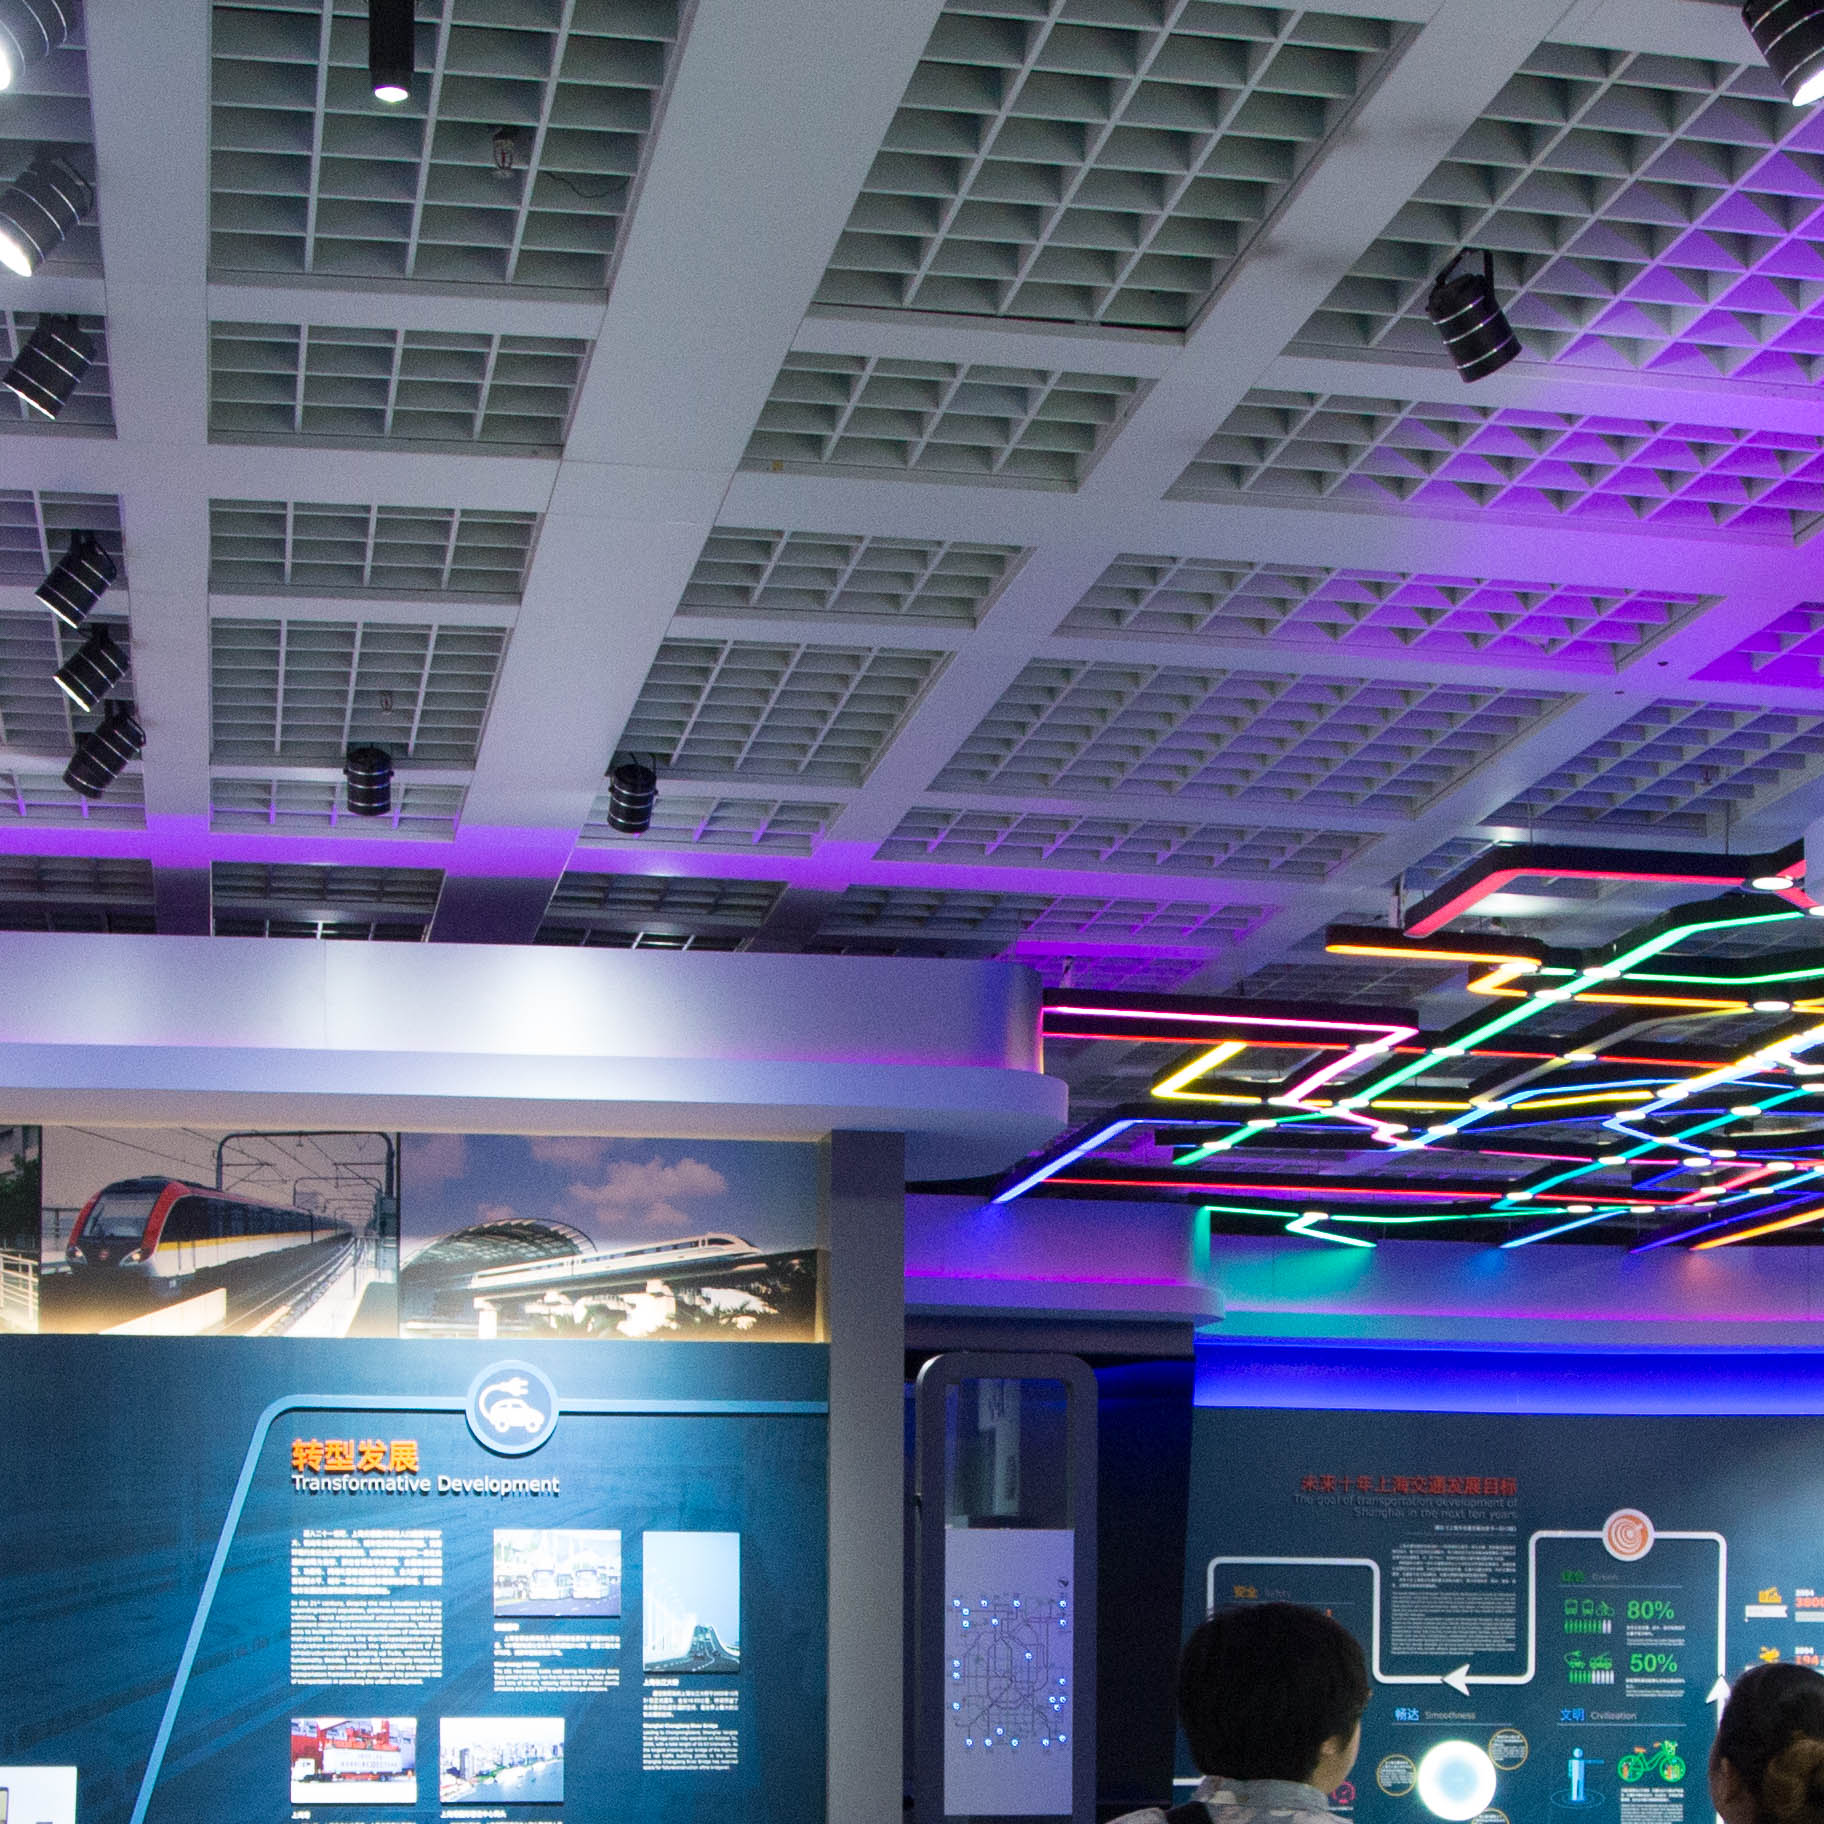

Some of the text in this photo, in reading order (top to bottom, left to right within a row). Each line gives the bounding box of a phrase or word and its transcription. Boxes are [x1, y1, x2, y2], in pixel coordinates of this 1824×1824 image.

[290, 1439, 420, 1474] 转型发展
[291, 1474, 561, 1498] Transformative Development
[1626, 1600, 1676, 1620] 80%
[1629, 1653, 1678, 1673] 50%
